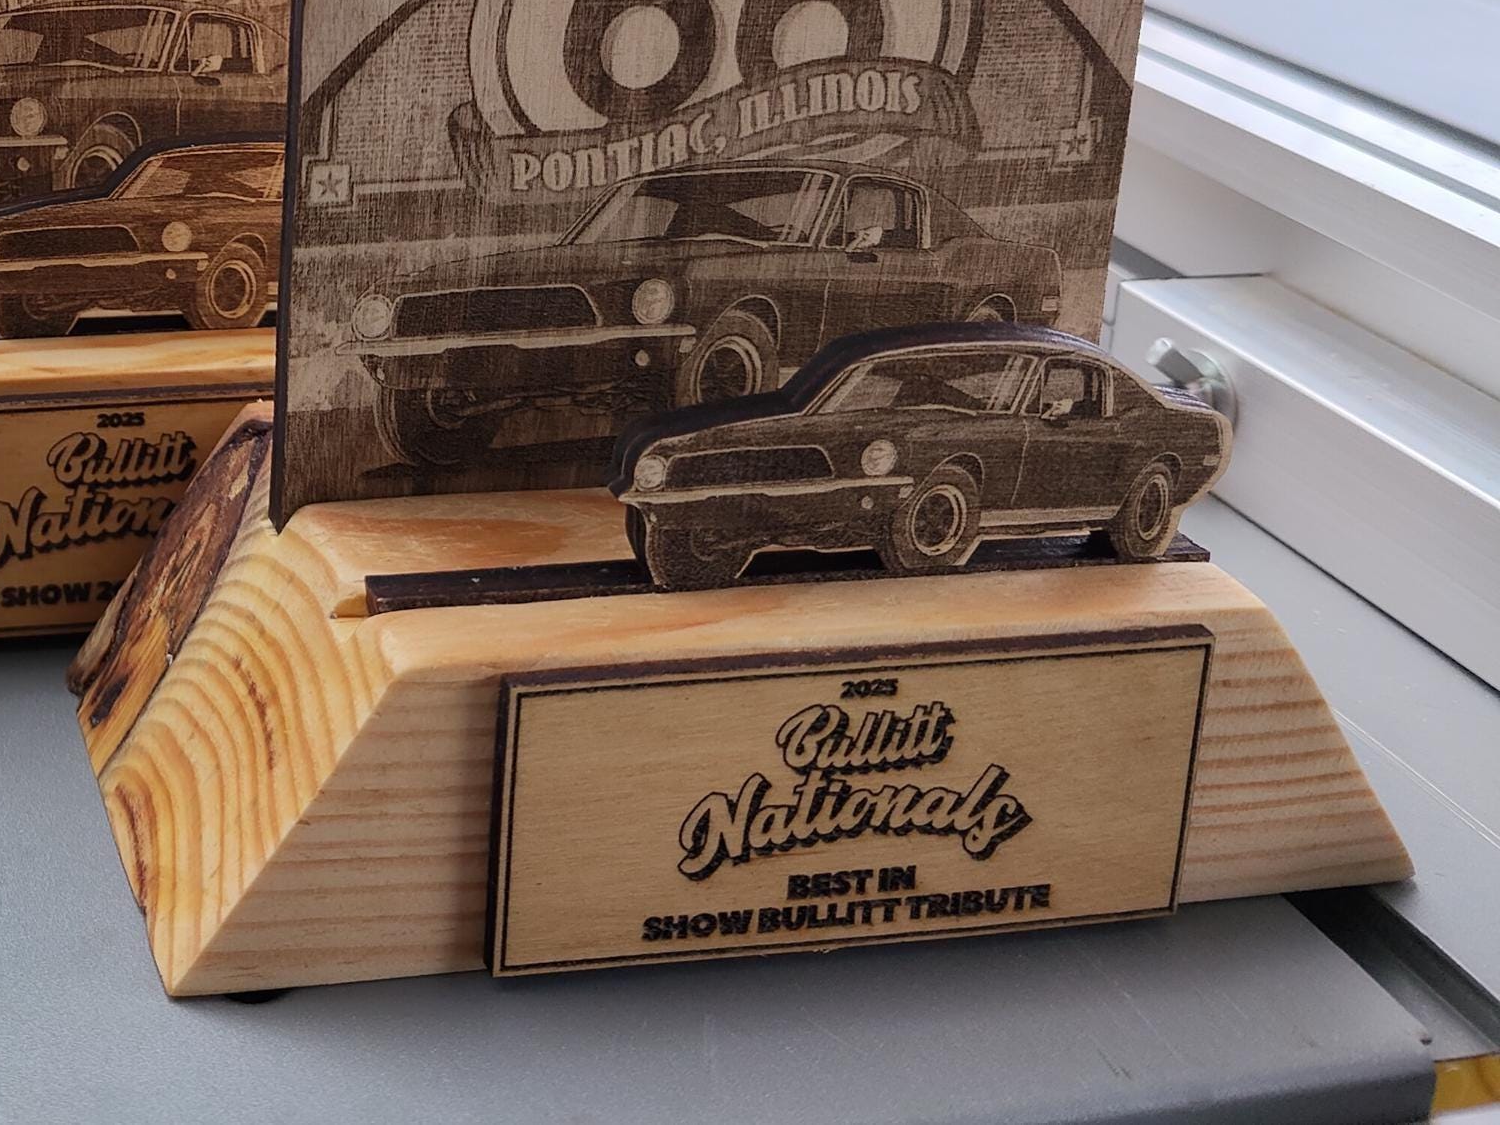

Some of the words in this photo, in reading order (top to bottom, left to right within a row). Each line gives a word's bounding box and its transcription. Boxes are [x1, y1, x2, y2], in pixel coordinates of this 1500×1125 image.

[510, 113, 728, 192] PONTIAC,
[737, 69, 921, 141] ILLINOIS
[96, 411, 145, 429] 2025
[46, 430, 198, 490] Bullitt
[0, 582, 93, 609] SHOW
[839, 678, 899, 699] 2025
[775, 700, 956, 774] Bullitt
[677, 763, 1033, 882] Nationals
[641, 908, 754, 942] SHOW
[757, 897, 902, 934] BULLITT
[905, 883, 1052, 921] TRIBUTE
[786, 868, 874, 901] BEST
[878, 865, 917, 892] IN
